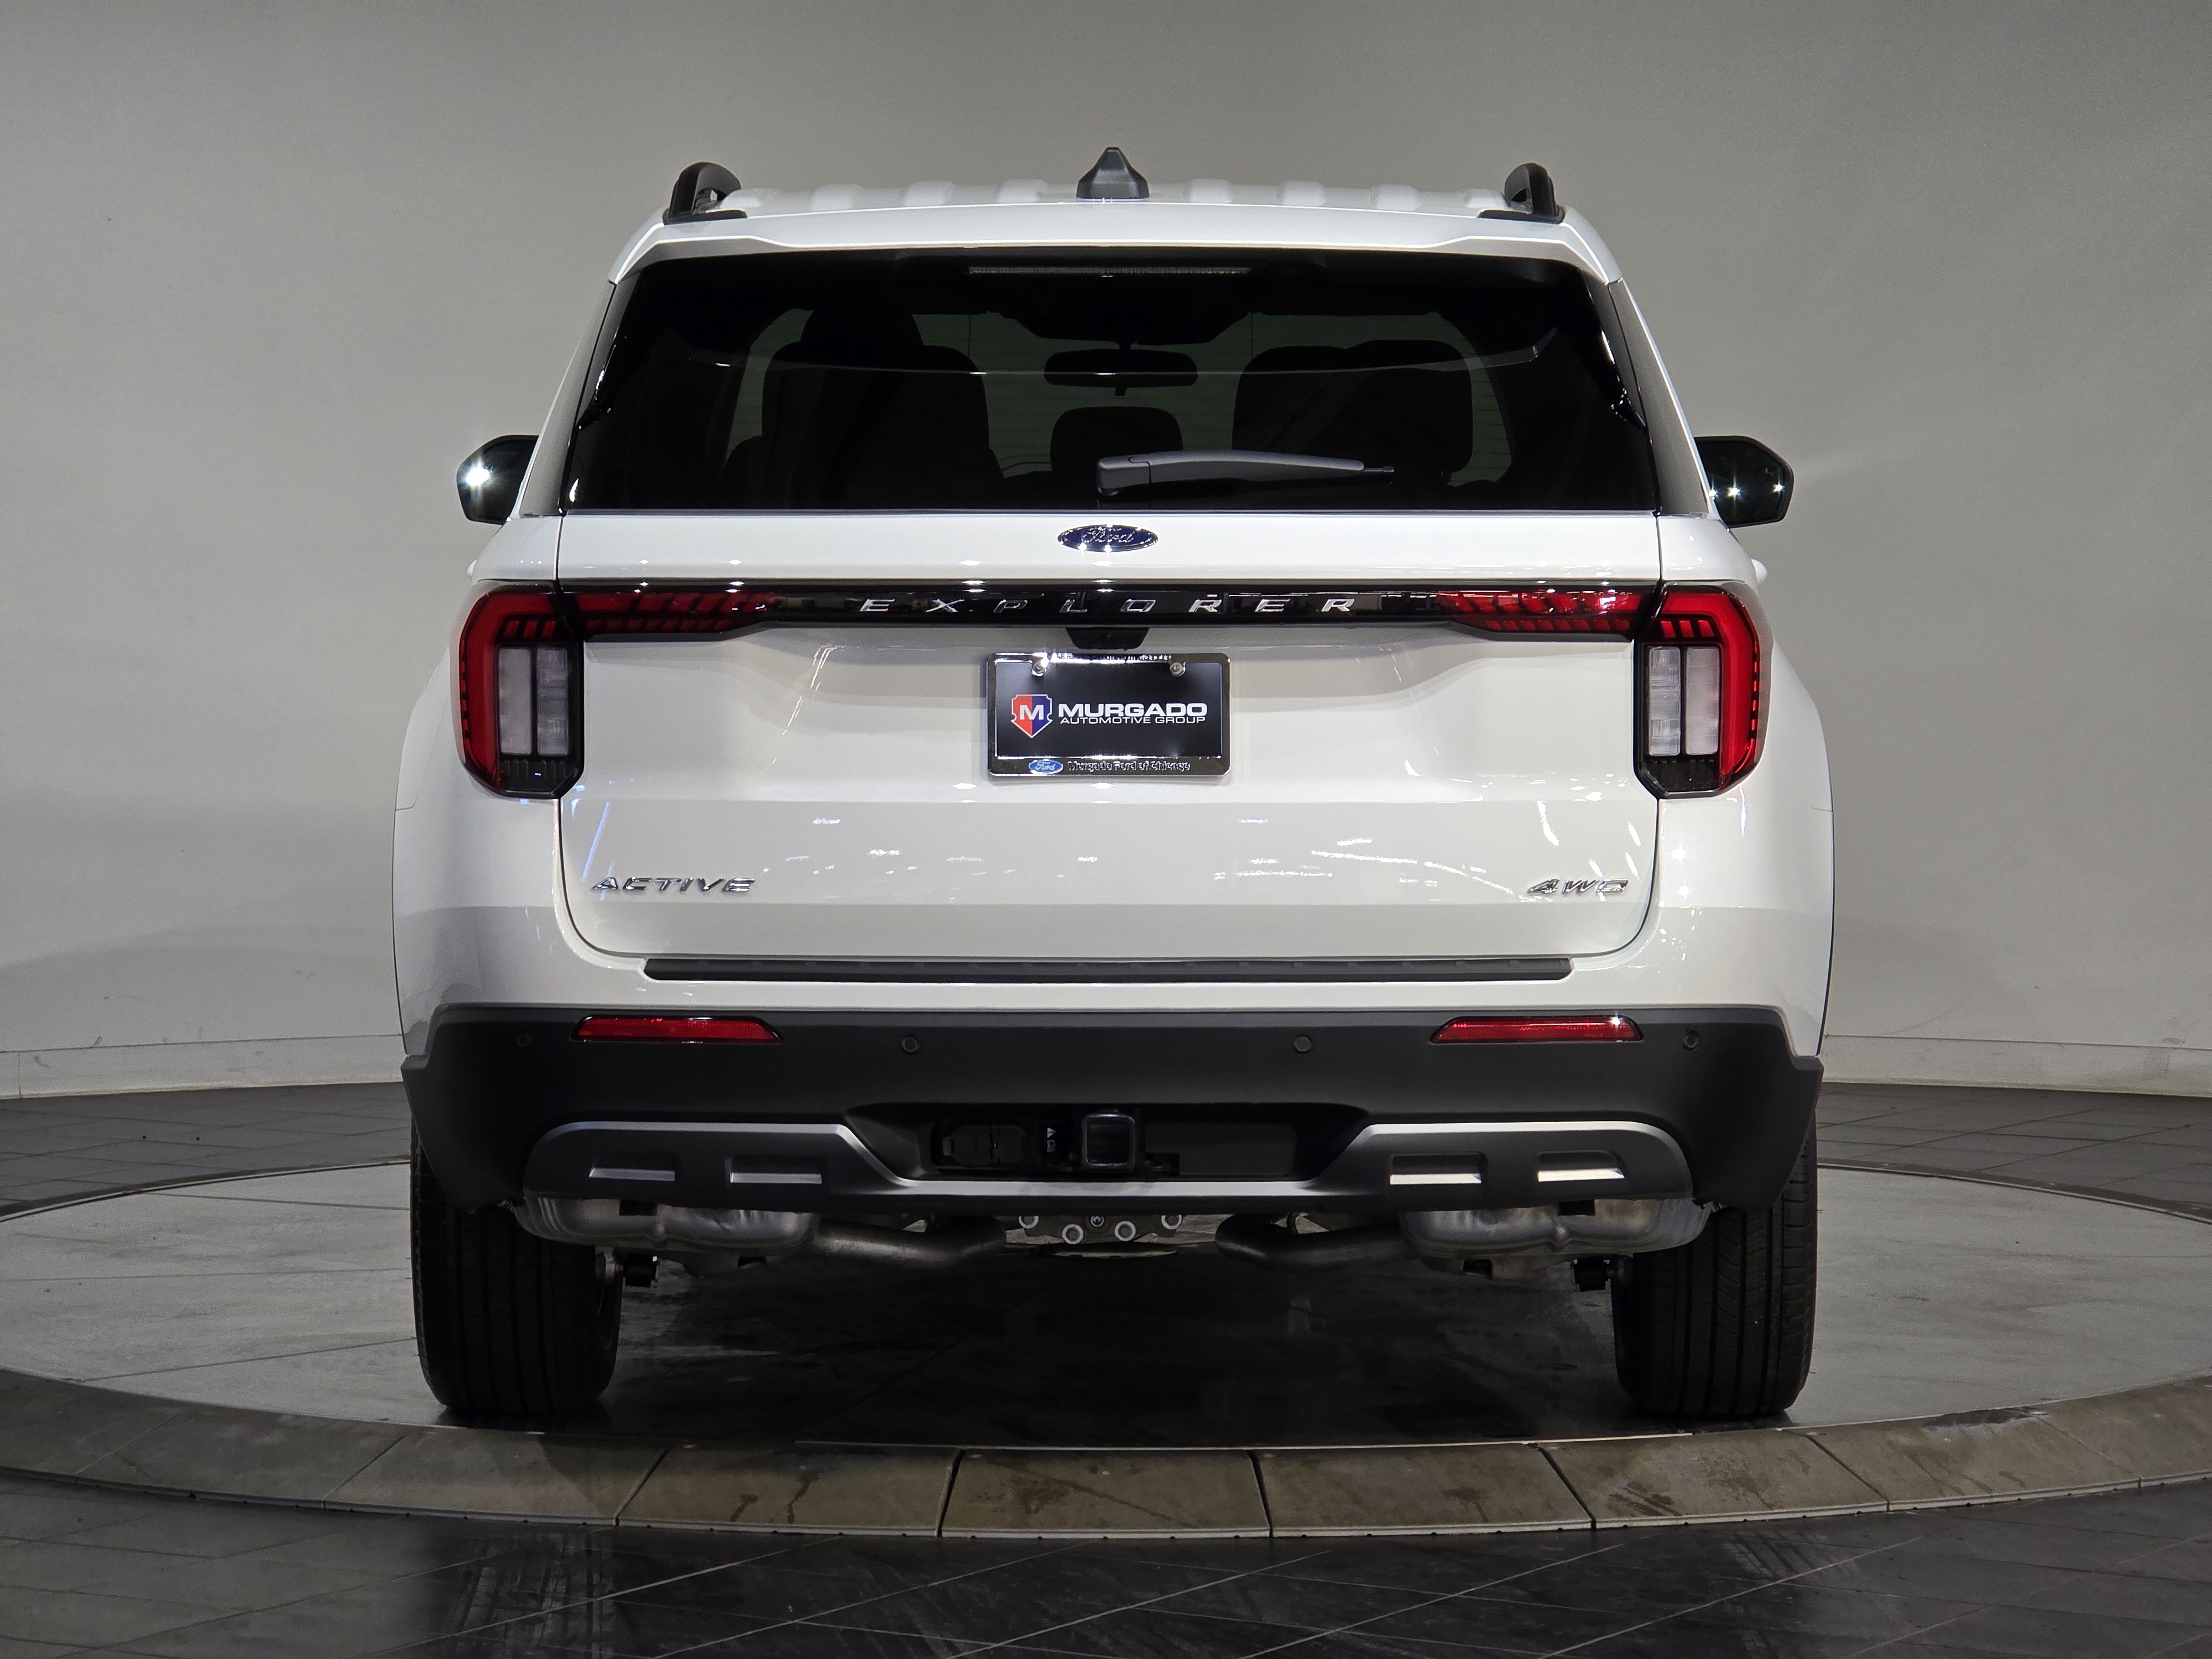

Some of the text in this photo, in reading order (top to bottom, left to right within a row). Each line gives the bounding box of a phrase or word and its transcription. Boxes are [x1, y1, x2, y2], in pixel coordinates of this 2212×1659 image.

[859, 598, 1355, 613] EXPLORER
[1019, 705, 1044, 720] M
[1058, 703, 1207, 717] MURGADO
[1035, 760, 1056, 770] Ford
[1067, 760, 1191, 772] Murgado Ford of Chicago
[592, 877, 755, 891] ACTIVE
[1527, 878, 1629, 894] 4WD
